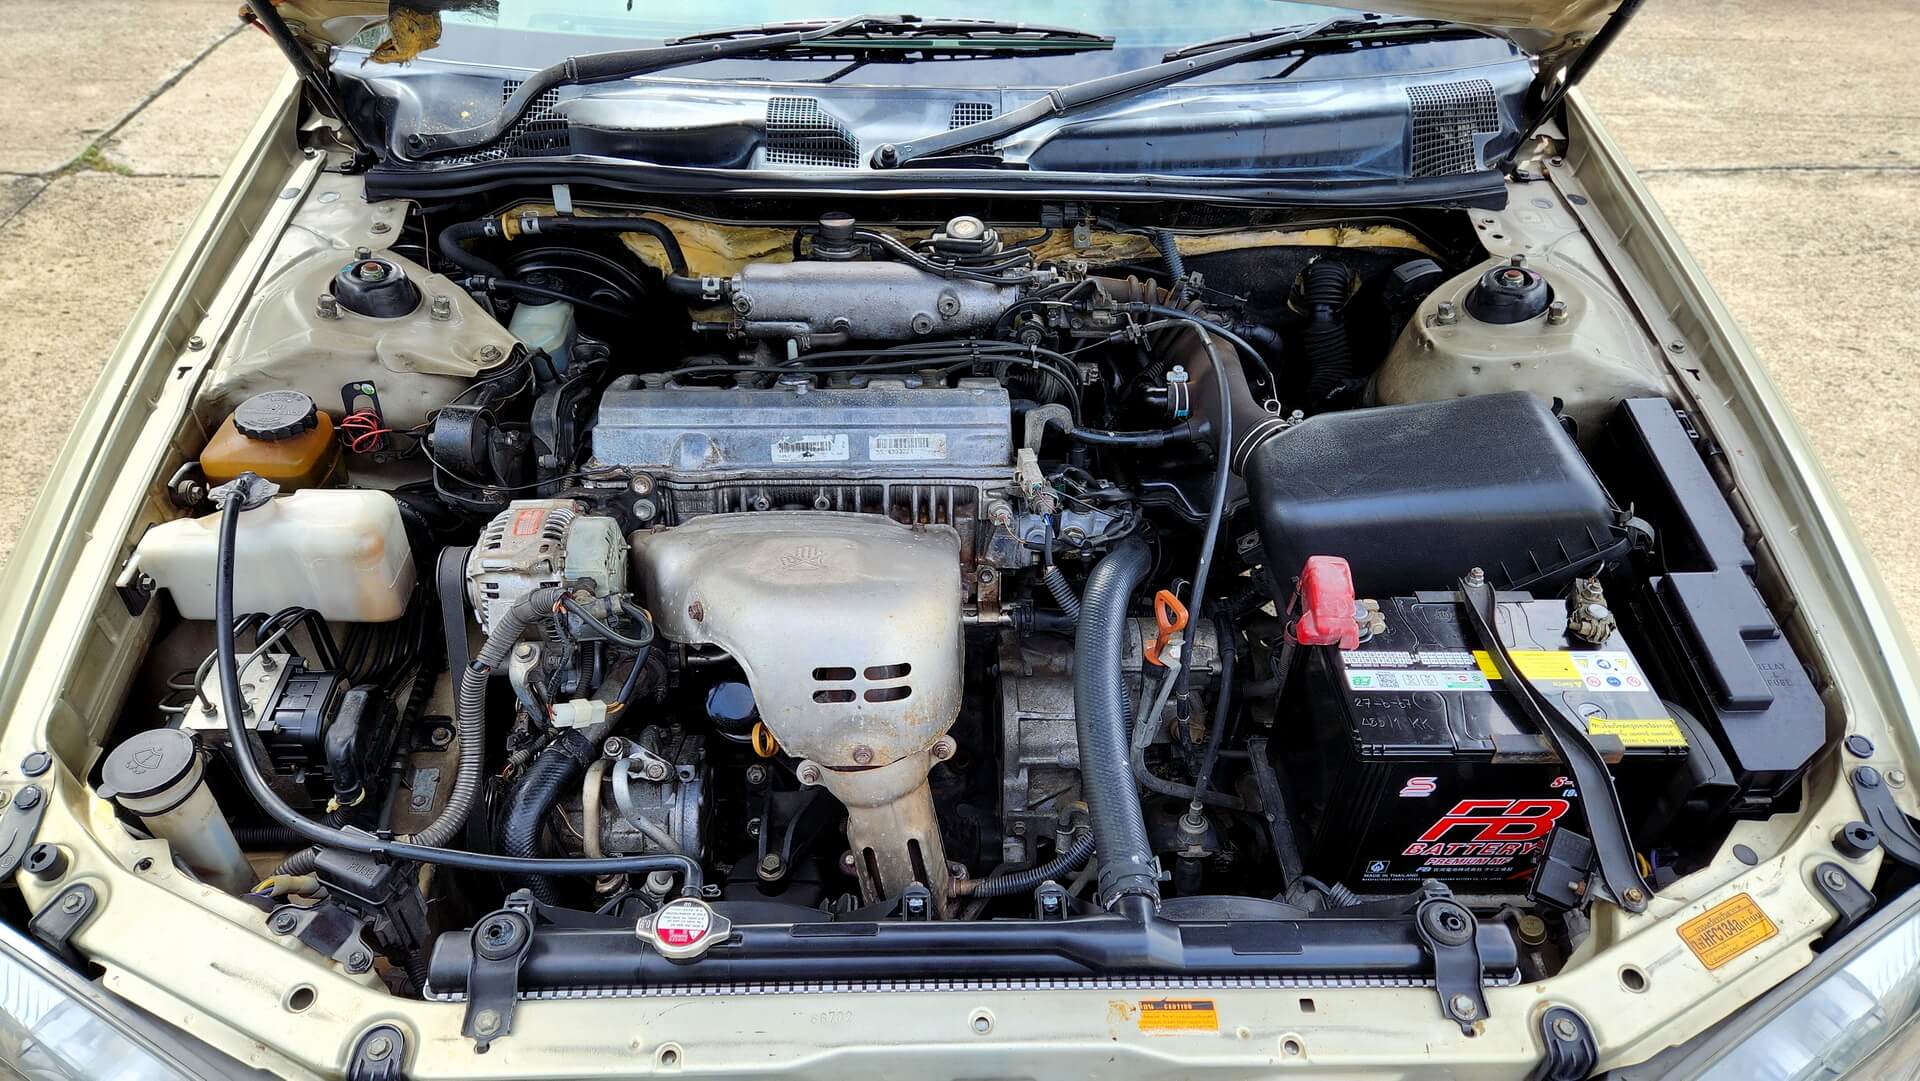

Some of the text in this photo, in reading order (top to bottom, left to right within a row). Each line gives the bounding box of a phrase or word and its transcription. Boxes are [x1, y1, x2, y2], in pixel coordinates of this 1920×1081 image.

[1417, 799, 1570, 841] FB
[1401, 842, 1539, 856] BATTERY
[1423, 856, 1490, 865] PREMIUM
